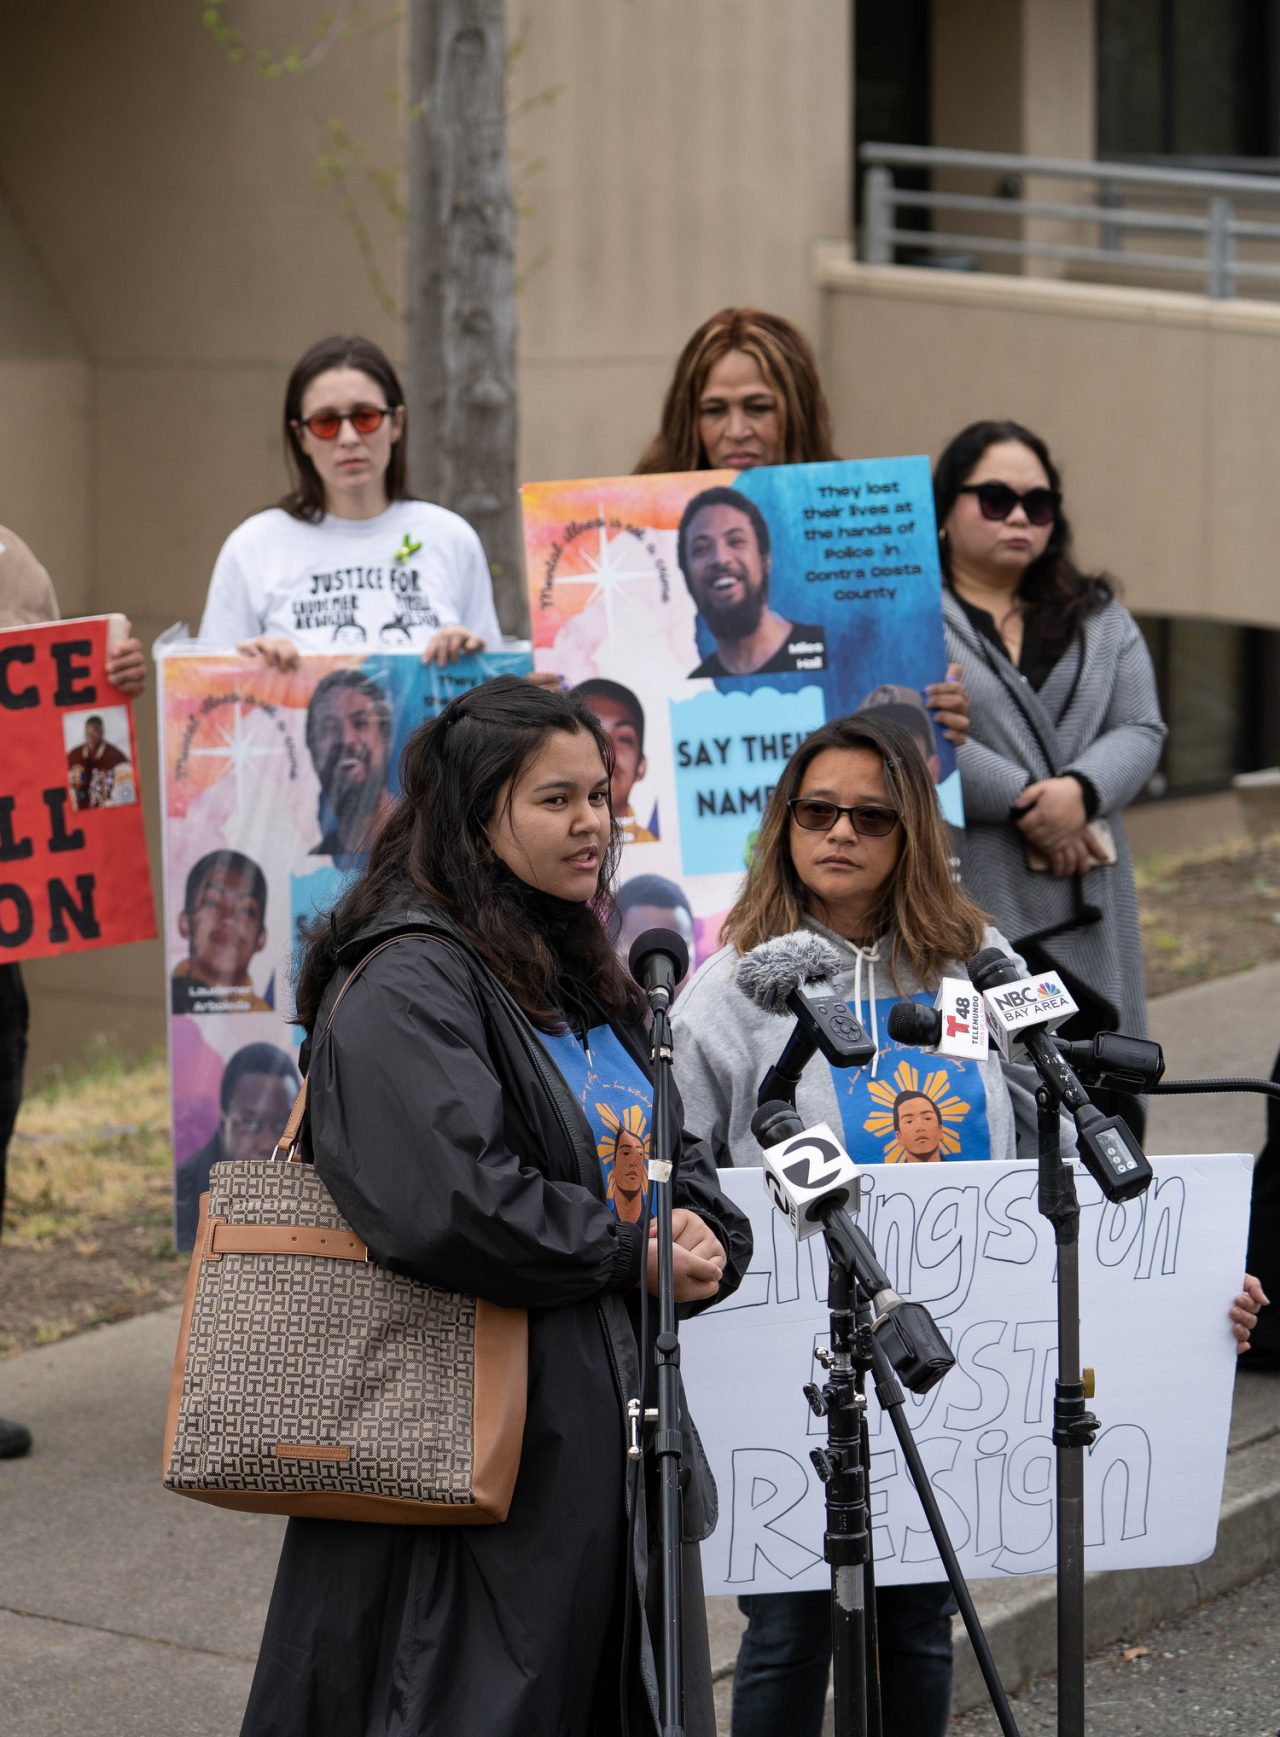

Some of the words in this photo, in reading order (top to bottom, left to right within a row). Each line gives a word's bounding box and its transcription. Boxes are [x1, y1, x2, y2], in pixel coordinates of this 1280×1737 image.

[817, 484, 861, 498] They
[866, 481, 899, 494] lost
[804, 504, 843, 520] their
[849, 502, 888, 516] lives
[895, 501, 913, 513] at
[804, 527, 833, 540] the
[838, 523, 892, 538] hands
[898, 519, 916, 533] of
[310, 566, 384, 594] JUSTICE
[389, 568, 422, 592] FOR
[677, 735, 731, 767] SAY
[956, 996, 971, 1020] 48
[994, 987, 1037, 1011] NBC
[1004, 1007, 1029, 1022] BAY
[1034, 997, 1070, 1014] AREA
[782, 1137, 842, 1189] 2
